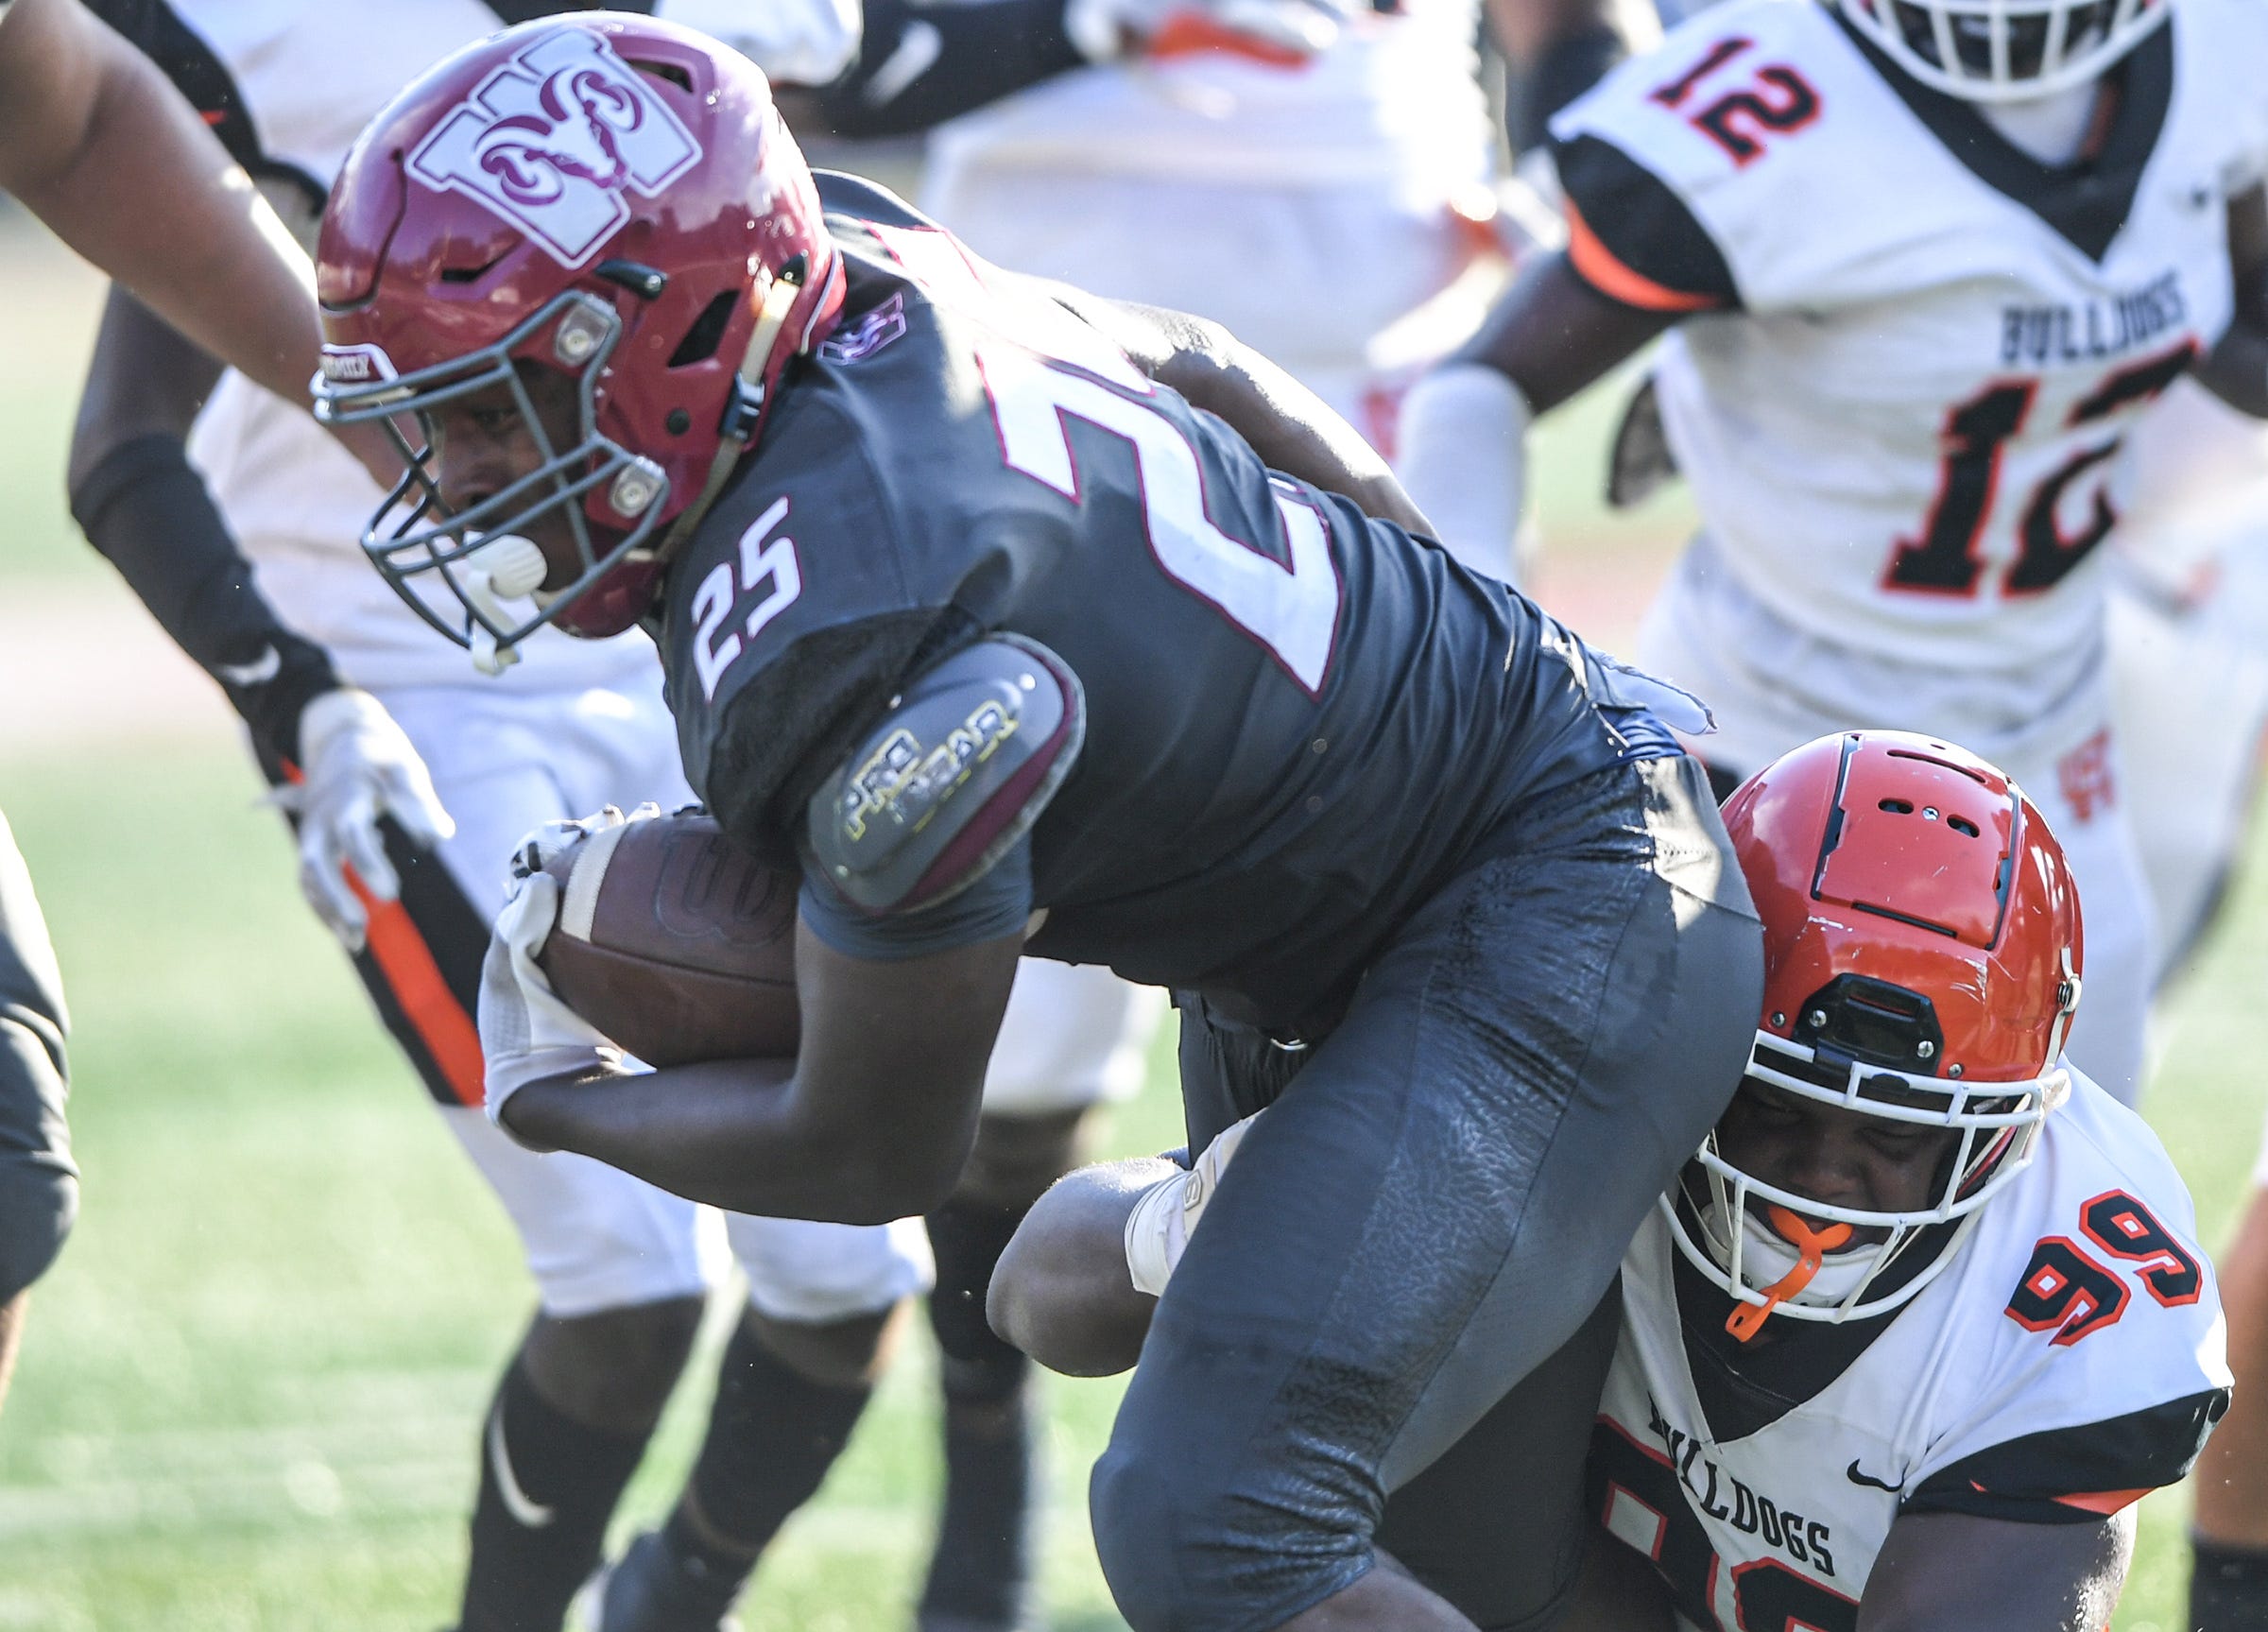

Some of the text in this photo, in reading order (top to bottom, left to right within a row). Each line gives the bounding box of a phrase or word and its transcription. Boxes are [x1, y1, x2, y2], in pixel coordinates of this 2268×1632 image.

[1648, 37, 1823, 171] 12
[1879, 333, 2204, 601] 12
[692, 494, 802, 702] 25
[2003, 1189, 2203, 1347] 99
